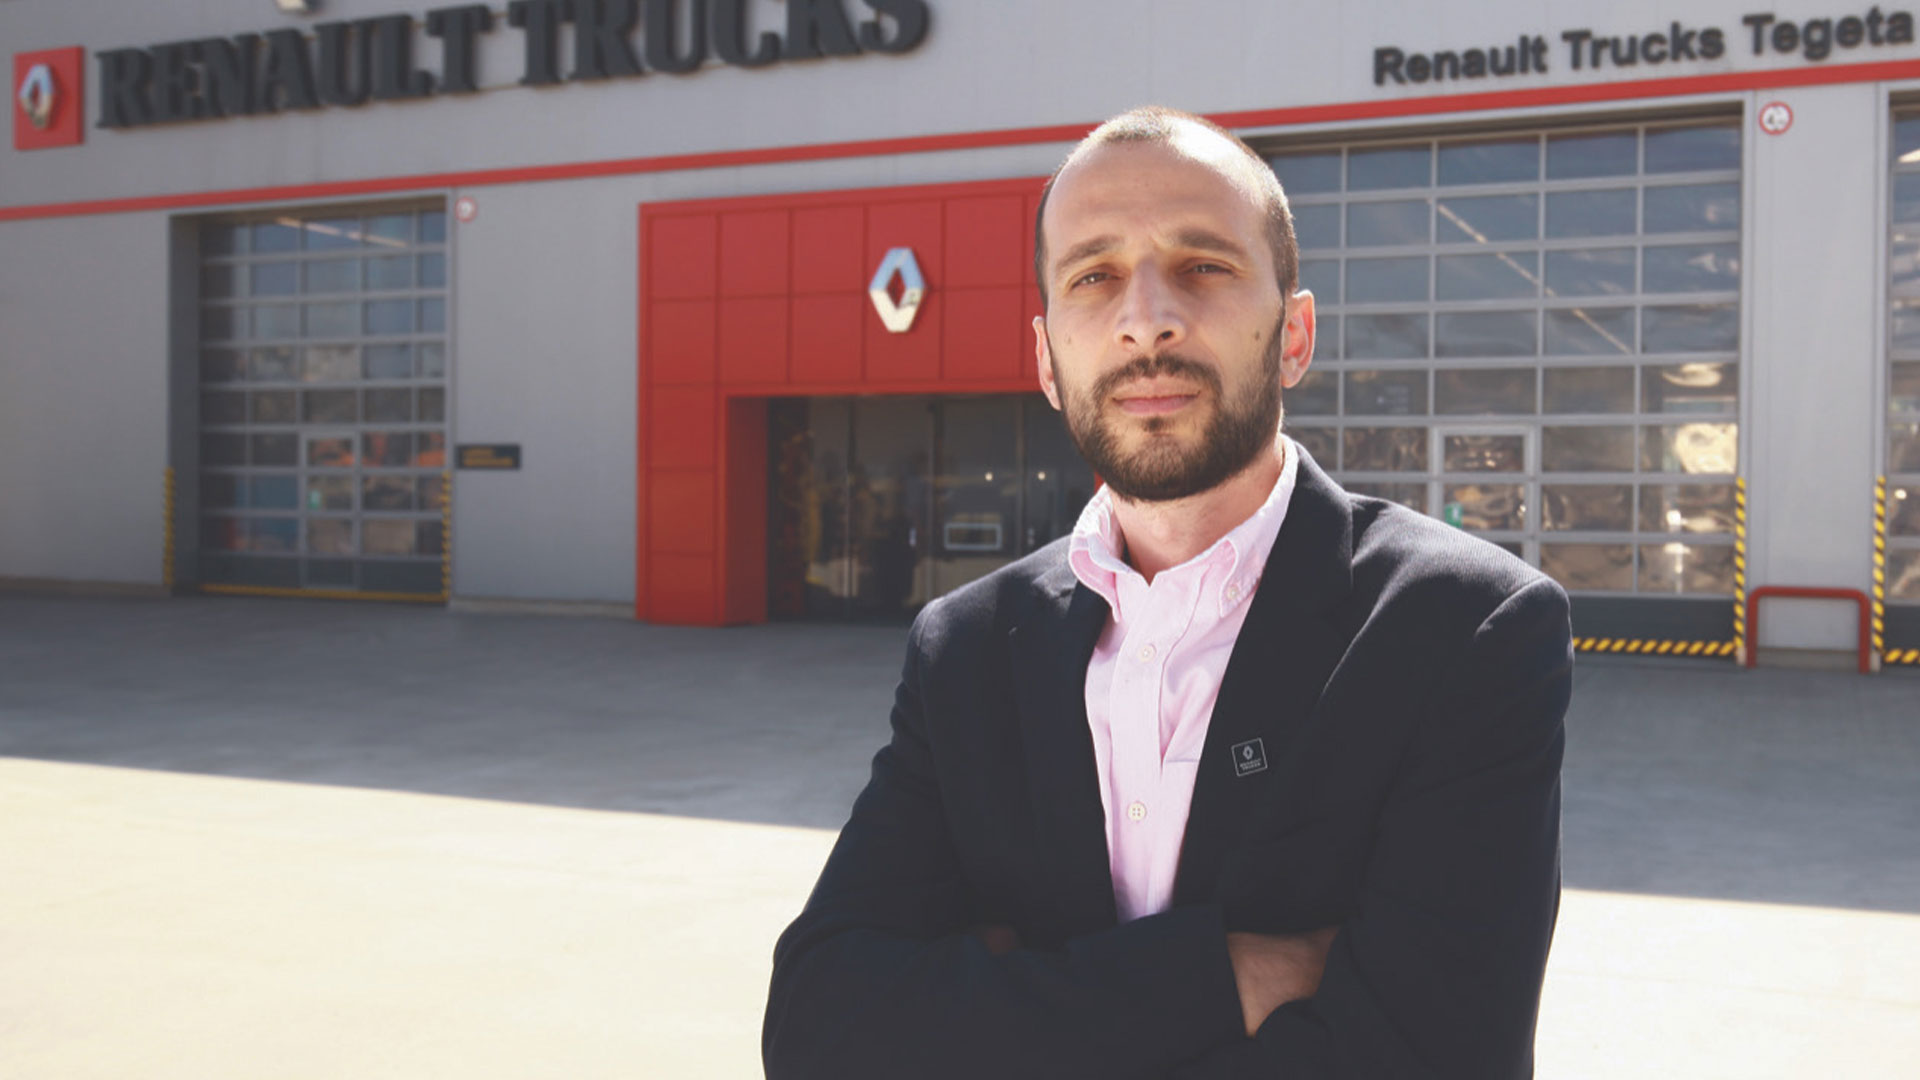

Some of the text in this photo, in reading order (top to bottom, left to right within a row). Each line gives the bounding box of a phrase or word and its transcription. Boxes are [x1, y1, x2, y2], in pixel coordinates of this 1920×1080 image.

[96, 0, 930, 128] RENAULT TRUCKS
[1373, 5, 1915, 86] Renault Trucks Tegeta
